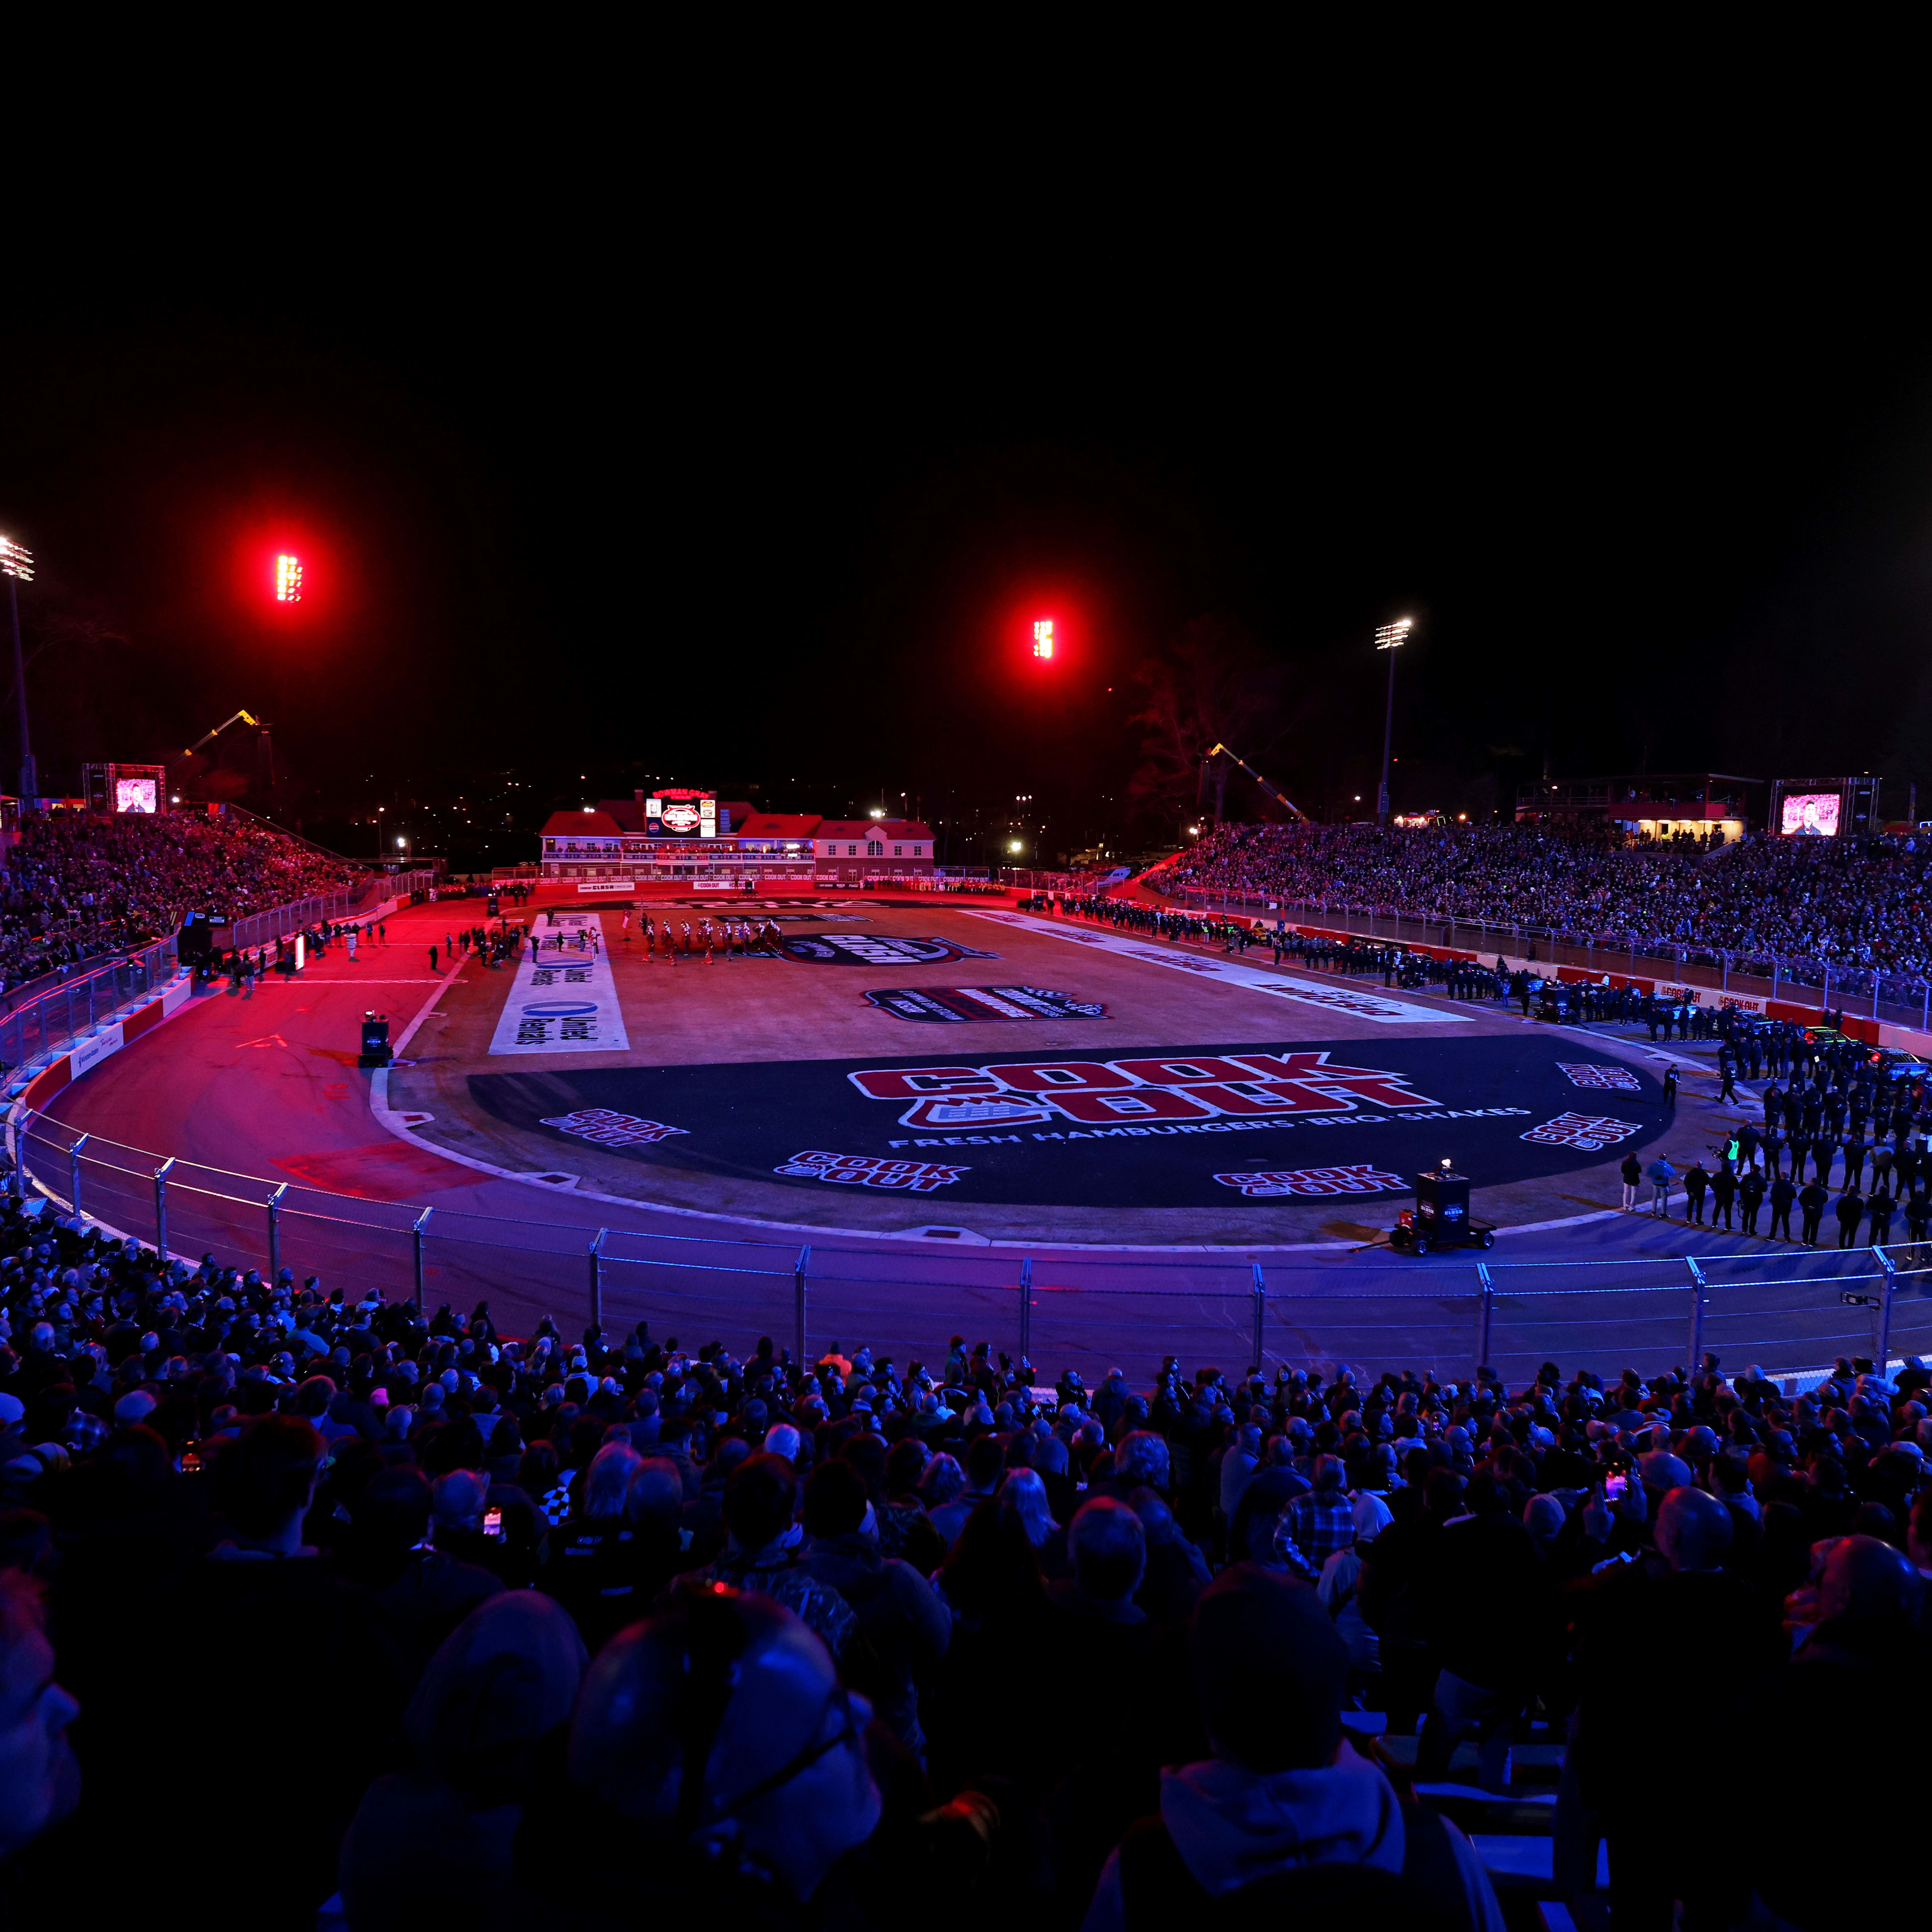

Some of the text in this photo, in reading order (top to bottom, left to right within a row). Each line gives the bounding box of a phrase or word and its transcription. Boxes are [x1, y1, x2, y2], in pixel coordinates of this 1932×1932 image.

[652, 788, 710, 799] BOWMAN GRAY
[820, 935, 922, 963] CLASH
[1121, 950, 1224, 972] DISCOUNT
[530, 970, 561, 986] Rentals
[564, 969, 593, 983] United
[955, 989, 1034, 1017] MADHOUSE
[1252, 984, 1407, 1016] DISCOUNT
[1321, 991, 1388, 1005] TIRE
[515, 1018, 555, 1045] Rentals
[560, 1017, 598, 1040] United
[847, 1051, 1408, 1100] COOK
[1555, 1062, 1612, 1089] COOK
[1592, 1065, 1639, 1083] OUT
[1037, 1076, 1445, 1123] OUT
[558, 1123, 650, 1147] OUT
[567, 1108, 691, 1142] COOK
[889, 1107, 1532, 1149] FRESH HAMBURGERS BBQ SHAKES
[1518, 1111, 1607, 1145] COOK
[1579, 1117, 1643, 1143] OUT
[787, 1151, 973, 1181] COOK
[1213, 1164, 1392, 1186] COOK
[819, 1168, 957, 1192] OUT
[1288, 1174, 1412, 1196] OUT
[1421, 1205, 1434, 1214] CLASH
